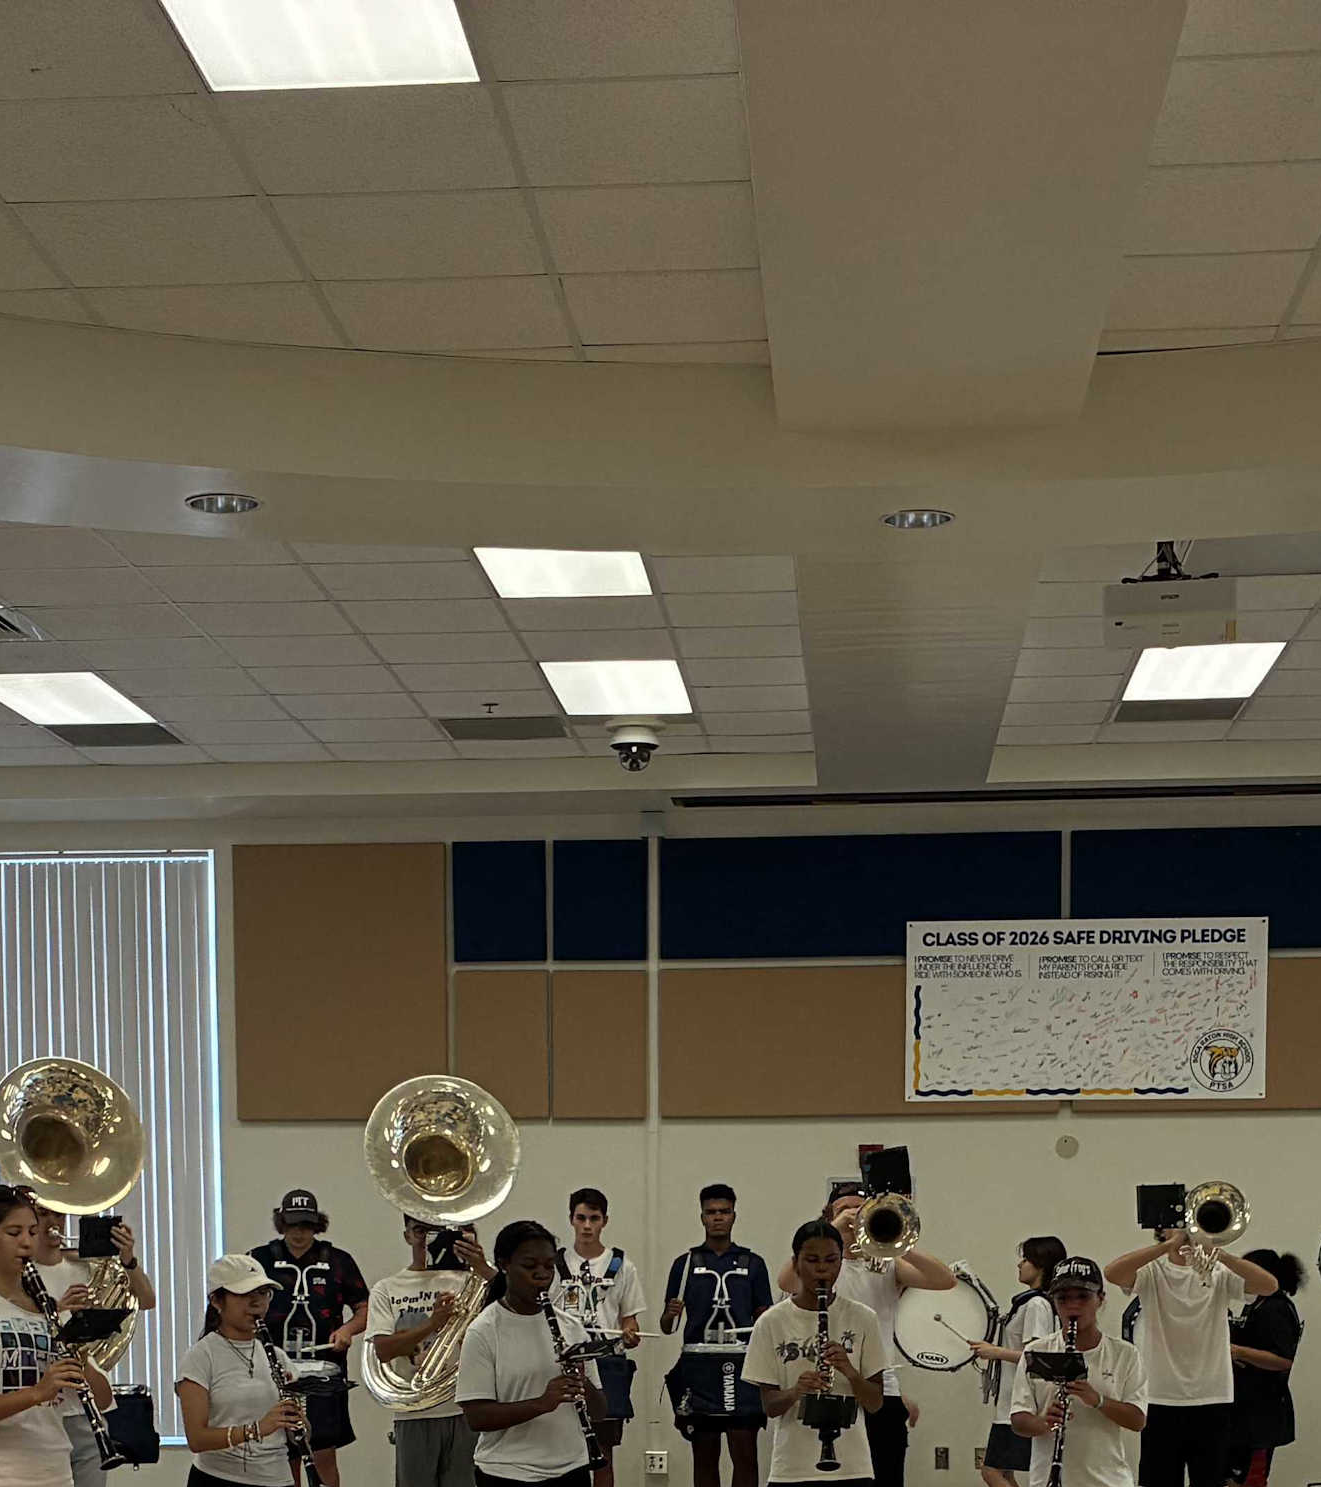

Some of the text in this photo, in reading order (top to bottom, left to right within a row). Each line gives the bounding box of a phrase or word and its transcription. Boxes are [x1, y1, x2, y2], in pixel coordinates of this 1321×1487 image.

[922, 928, 1246, 947] CLASS OF 2026 SAFE DRIVING PLEDGE
[917, 955, 953, 963] PROMISE
[954, 955, 964, 963] TO
[966, 954, 990, 962] NEVER
[1042, 955, 1077, 963] PROMISE
[1079, 955, 1089, 963] TO
[1091, 955, 1109, 963] CALL
[1125, 954, 1143, 962] TEXT
[1166, 952, 1201, 960] PROMISE
[1203, 952, 1214, 960] TO
[1215, 951, 1249, 960] RESPECT
[1164, 960, 1176, 968] THE
[1238, 959, 1257, 967] THAT
[1162, 968, 1192, 976] COMES
[1192, 967, 1213, 975] WITH
[723, 1374, 735, 1411] YAMAHA
